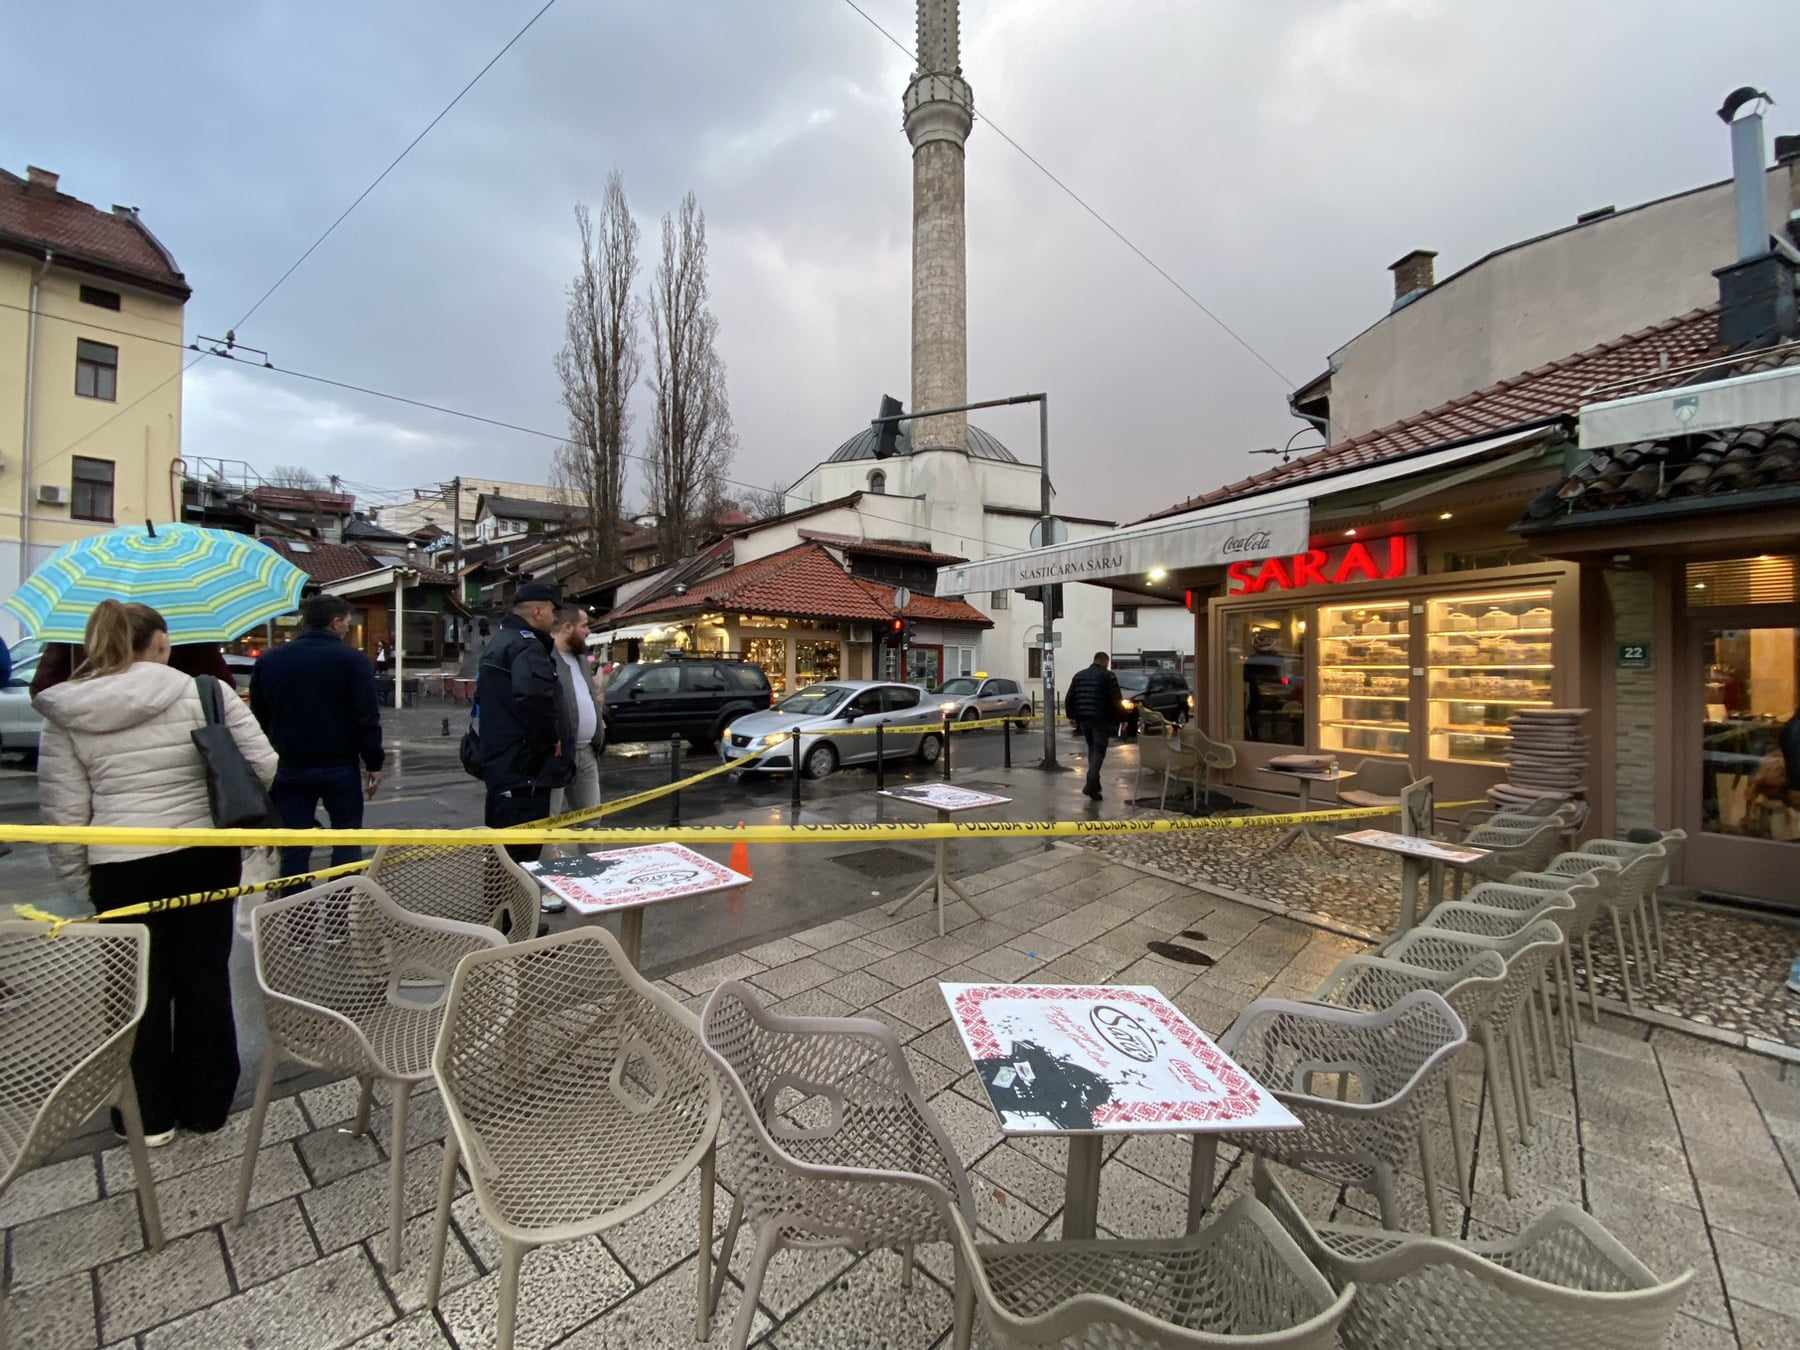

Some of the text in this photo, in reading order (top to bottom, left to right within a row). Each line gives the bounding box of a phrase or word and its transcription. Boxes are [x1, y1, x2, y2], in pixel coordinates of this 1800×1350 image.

[1086, 555, 1123, 571] SARAJ
[1228, 536, 1407, 596] SARAJ
[1624, 647, 1643, 658] 22
